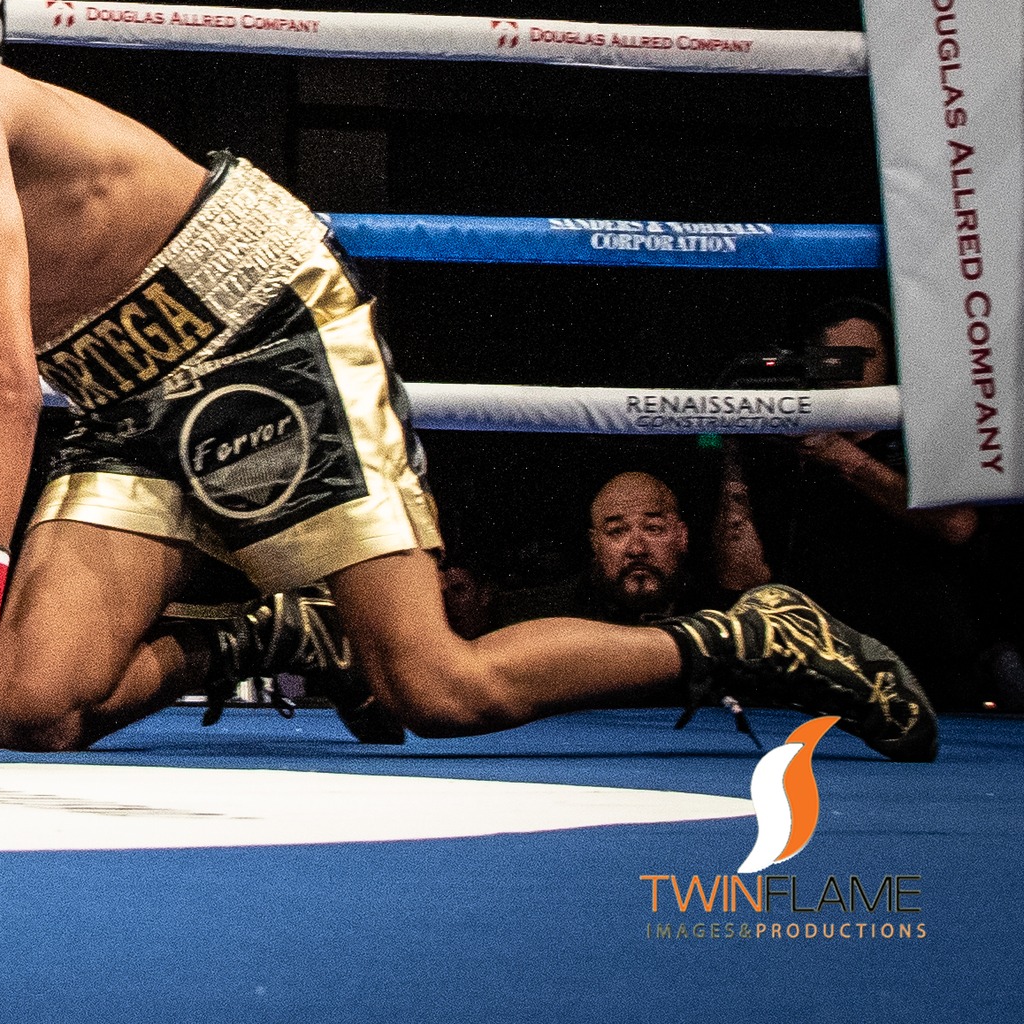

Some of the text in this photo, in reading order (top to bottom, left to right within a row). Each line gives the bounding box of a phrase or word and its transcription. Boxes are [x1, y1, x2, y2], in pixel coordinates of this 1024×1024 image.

[86, 6, 320, 34] DOUGLAS ALLRED COMPANY
[530, 27, 753, 54] DOUGLAS ALLRED COMPANY
[946, 139, 984, 280] ALLRED
[590, 233, 737, 252] CORPORATION
[963, 290, 1005, 474] COMPANY
[626, 396, 811, 414] RENAISSANCE
